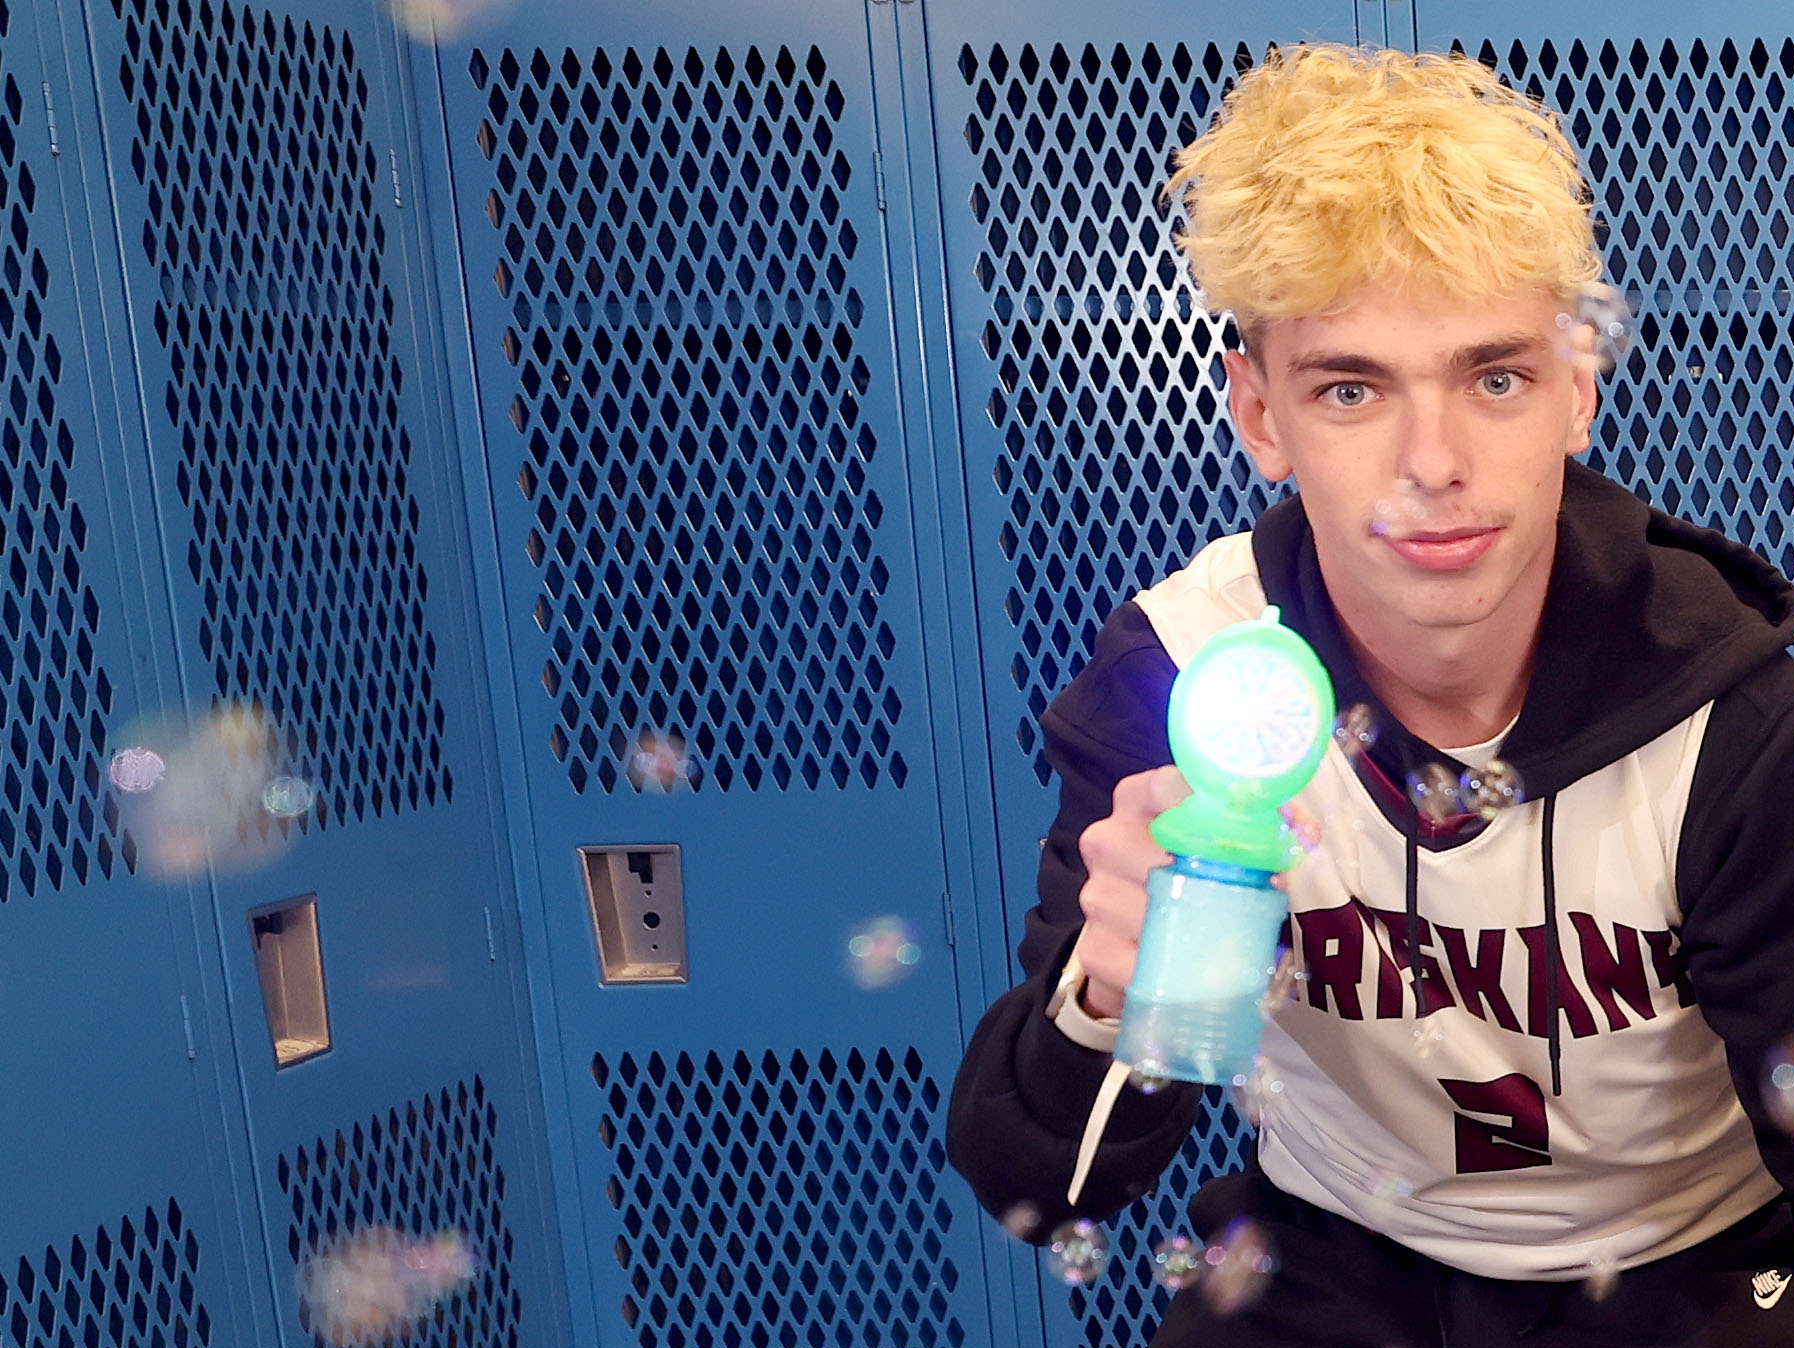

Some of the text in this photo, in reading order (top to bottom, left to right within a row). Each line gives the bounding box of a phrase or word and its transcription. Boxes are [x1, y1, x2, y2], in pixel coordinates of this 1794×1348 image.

[1276, 895, 1697, 1040] RISKANY
[1437, 1072, 1553, 1175] 2
[1751, 1269, 1784, 1297] NIKE
